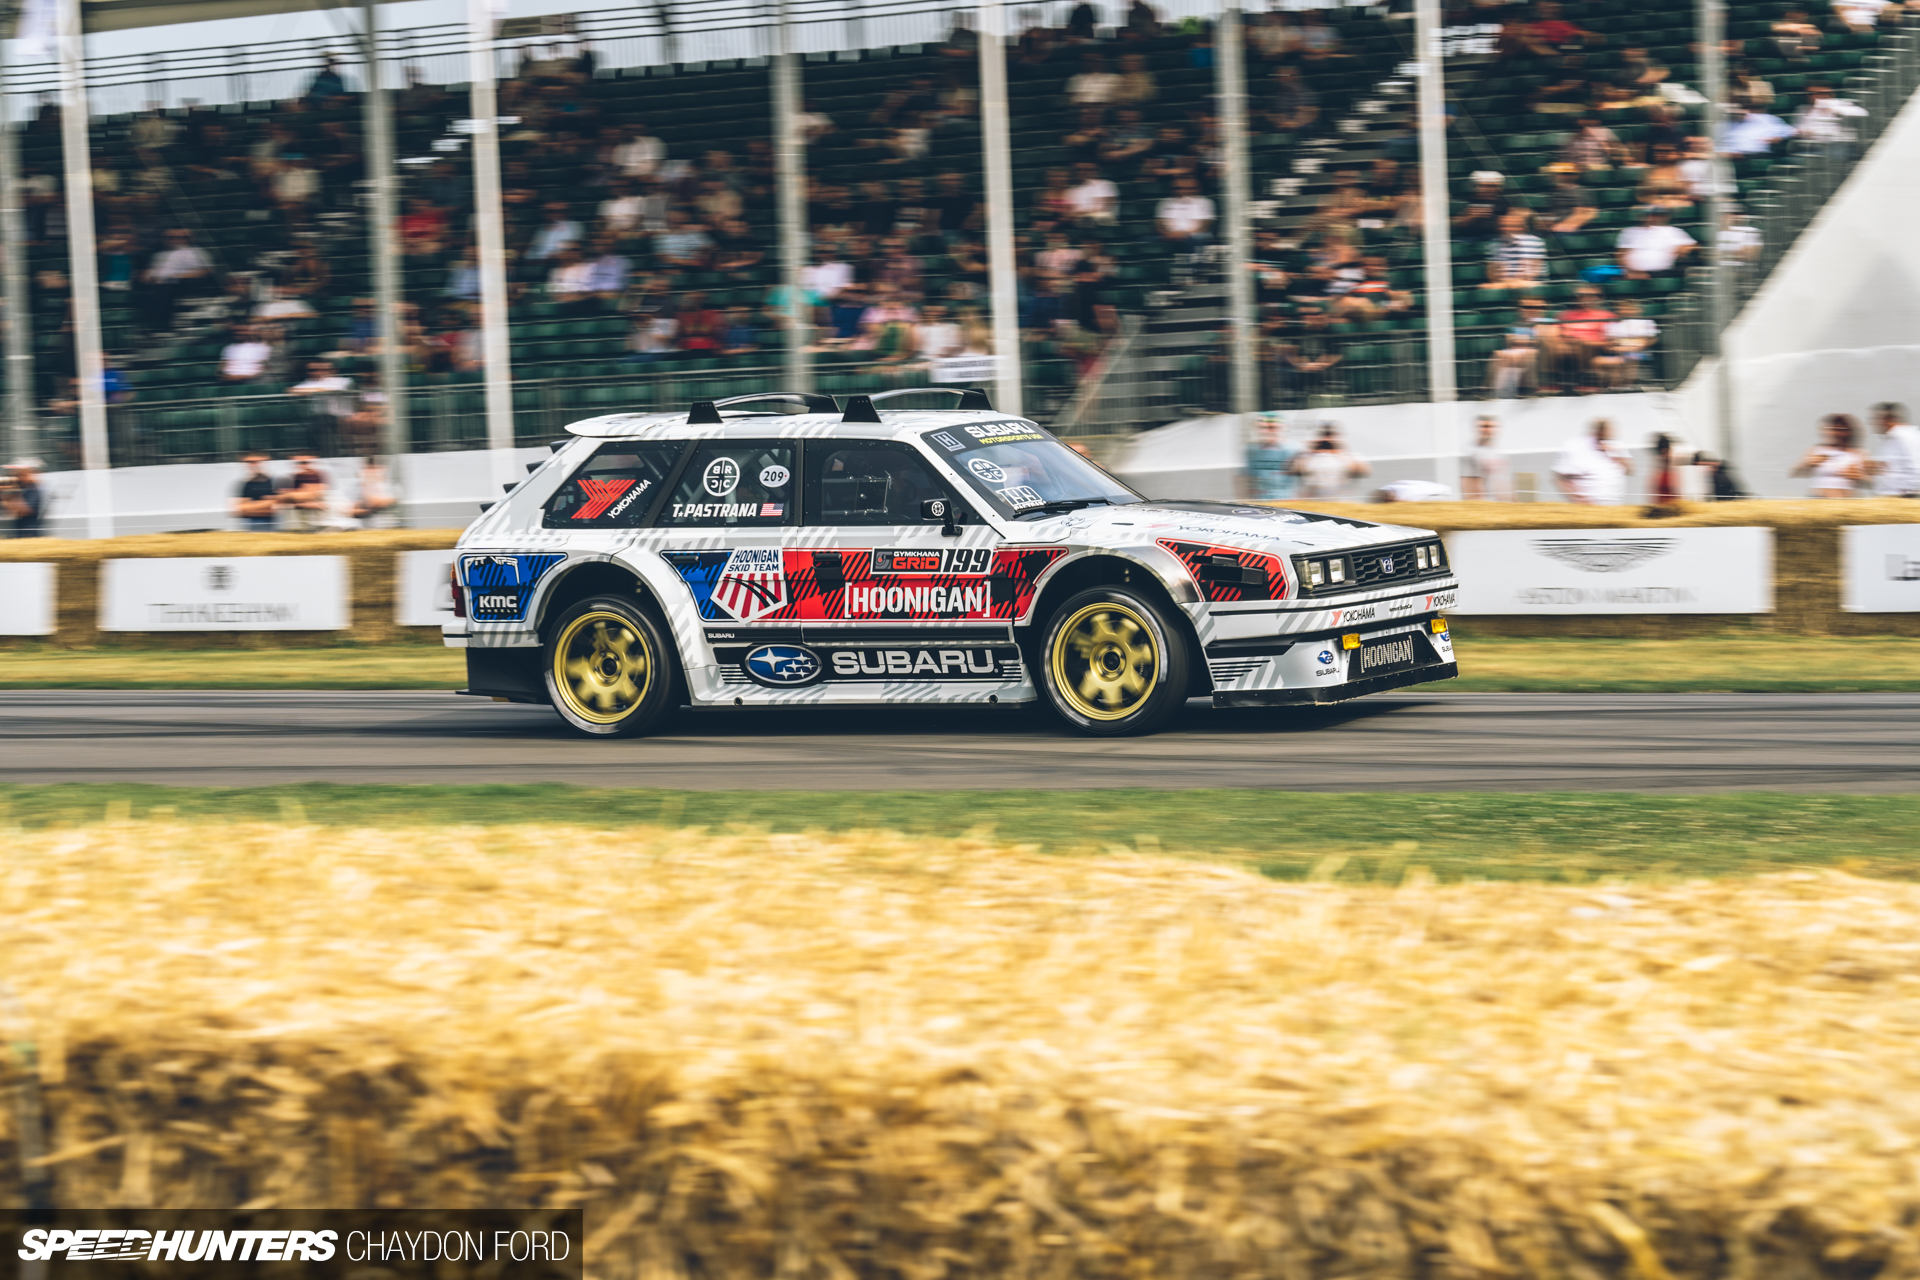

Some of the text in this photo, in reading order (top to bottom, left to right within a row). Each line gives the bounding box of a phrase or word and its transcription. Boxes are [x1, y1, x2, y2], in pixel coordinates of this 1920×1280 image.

[964, 422, 1036, 438] SUBARU
[763, 470, 784, 482] 209
[607, 479, 652, 519] YOKOHAMA
[1179, 525, 1280, 541] YOKOHAMA
[732, 549, 779, 563] HOONIGAN
[893, 550, 940, 558] GYMKHANA
[943, 549, 992, 573] 199
[728, 563, 779, 572] SKID TEAM
[479, 595, 518, 608] KMC
[1432, 594, 1456, 607] YOKOHAMA
[1342, 607, 1376, 623] YOKOHAMA
[831, 649, 996, 675] SUBARU
